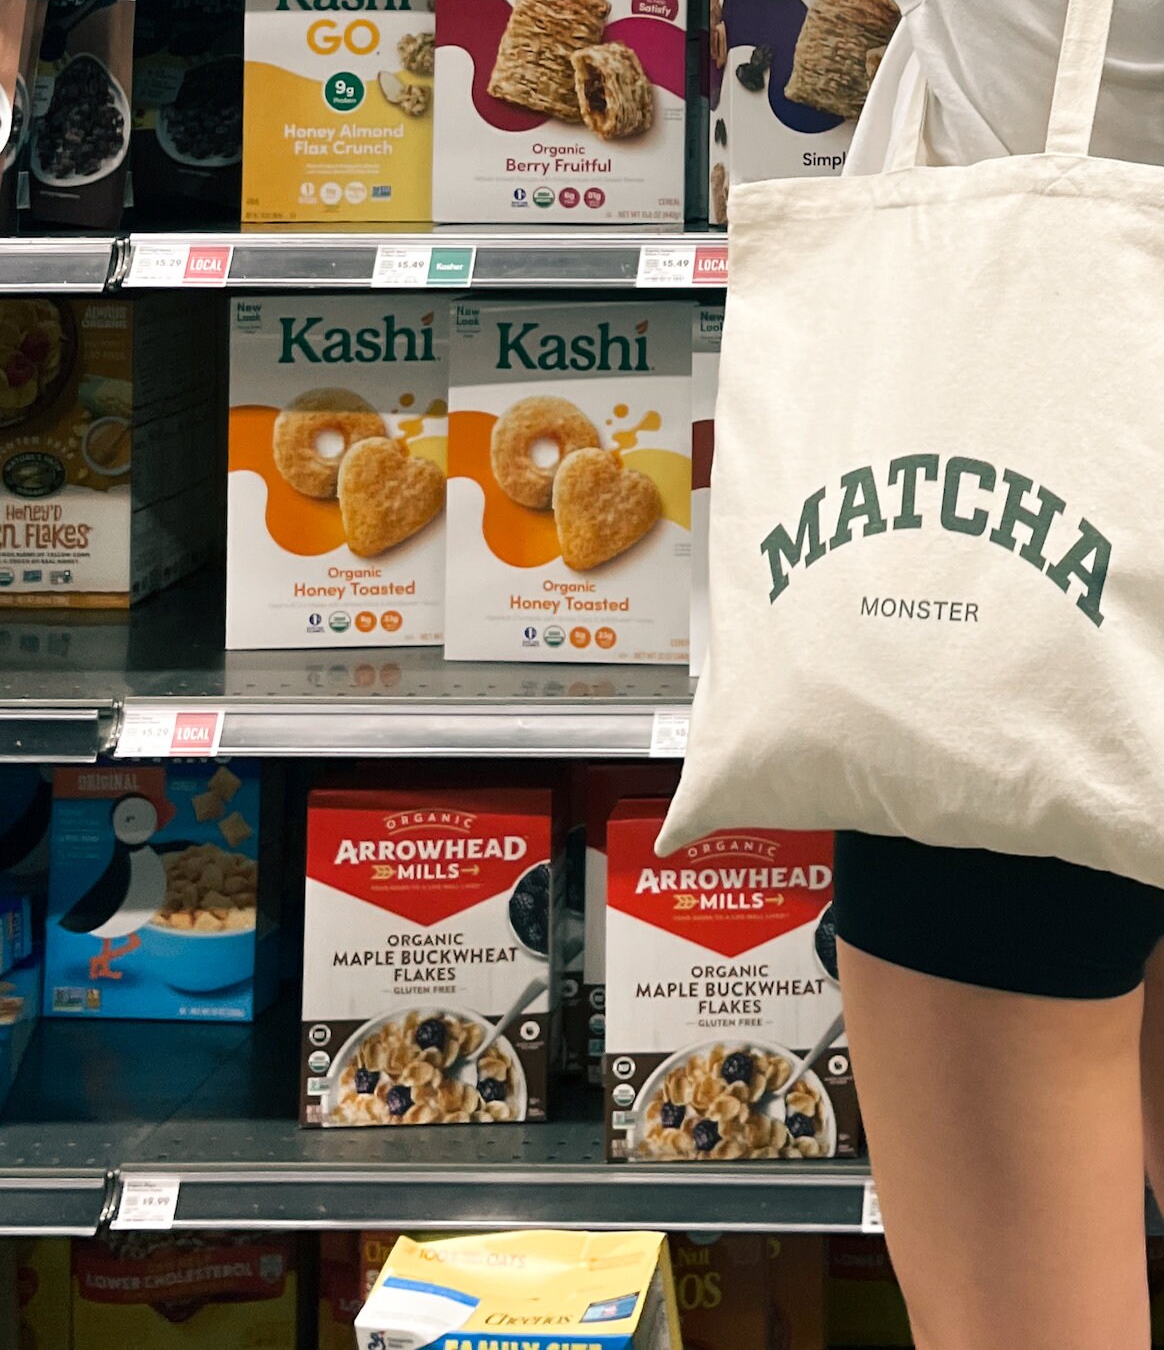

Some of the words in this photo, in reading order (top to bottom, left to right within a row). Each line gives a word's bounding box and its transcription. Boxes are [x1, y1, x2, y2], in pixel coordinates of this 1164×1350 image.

[638, 3, 672, 16] Satisfy
[307, 19, 380, 55] GO
[284, 124, 336, 139] Honey
[340, 124, 404, 139] Almond
[294, 141, 328, 155] Flax
[332, 141, 393, 155] Crunch
[532, 143, 585, 156] Organic
[506, 159, 550, 175] Berry
[554, 158, 611, 172] Fruitful
[190, 258, 222, 273] LOCAL
[436, 261, 464, 271] Kosher
[278, 312, 435, 364] Kashi
[496, 319, 650, 371] Kashi
[760, 453, 1112, 628] MATCHA
[328, 566, 382, 580] Organic
[294, 582, 345, 600] Honey
[351, 581, 416, 598] Toasted
[510, 596, 560, 614] Honey
[564, 597, 629, 613] Toasted
[860, 596, 979, 623] MONSTER
[177, 726, 209, 741] LOCAL
[78, 773, 140, 791] ORIGINAL
[334, 836, 527, 865] ARROWHEAD
[397, 864, 460, 880] MILLS
[635, 865, 832, 894] ARROWHEAD
[700, 893, 764, 910] MILLS
[387, 933, 464, 946] ORGANIC
[333, 950, 394, 966] MAPLE
[401, 947, 519, 965] BUCKWHEAT
[394, 968, 456, 982] FLAKES
[691, 965, 768, 979] ORGANIC
[635, 982, 698, 998] MAPLE
[705, 979, 825, 997] BUCKWHEAT
[698, 1000, 762, 1015] FLAKES
